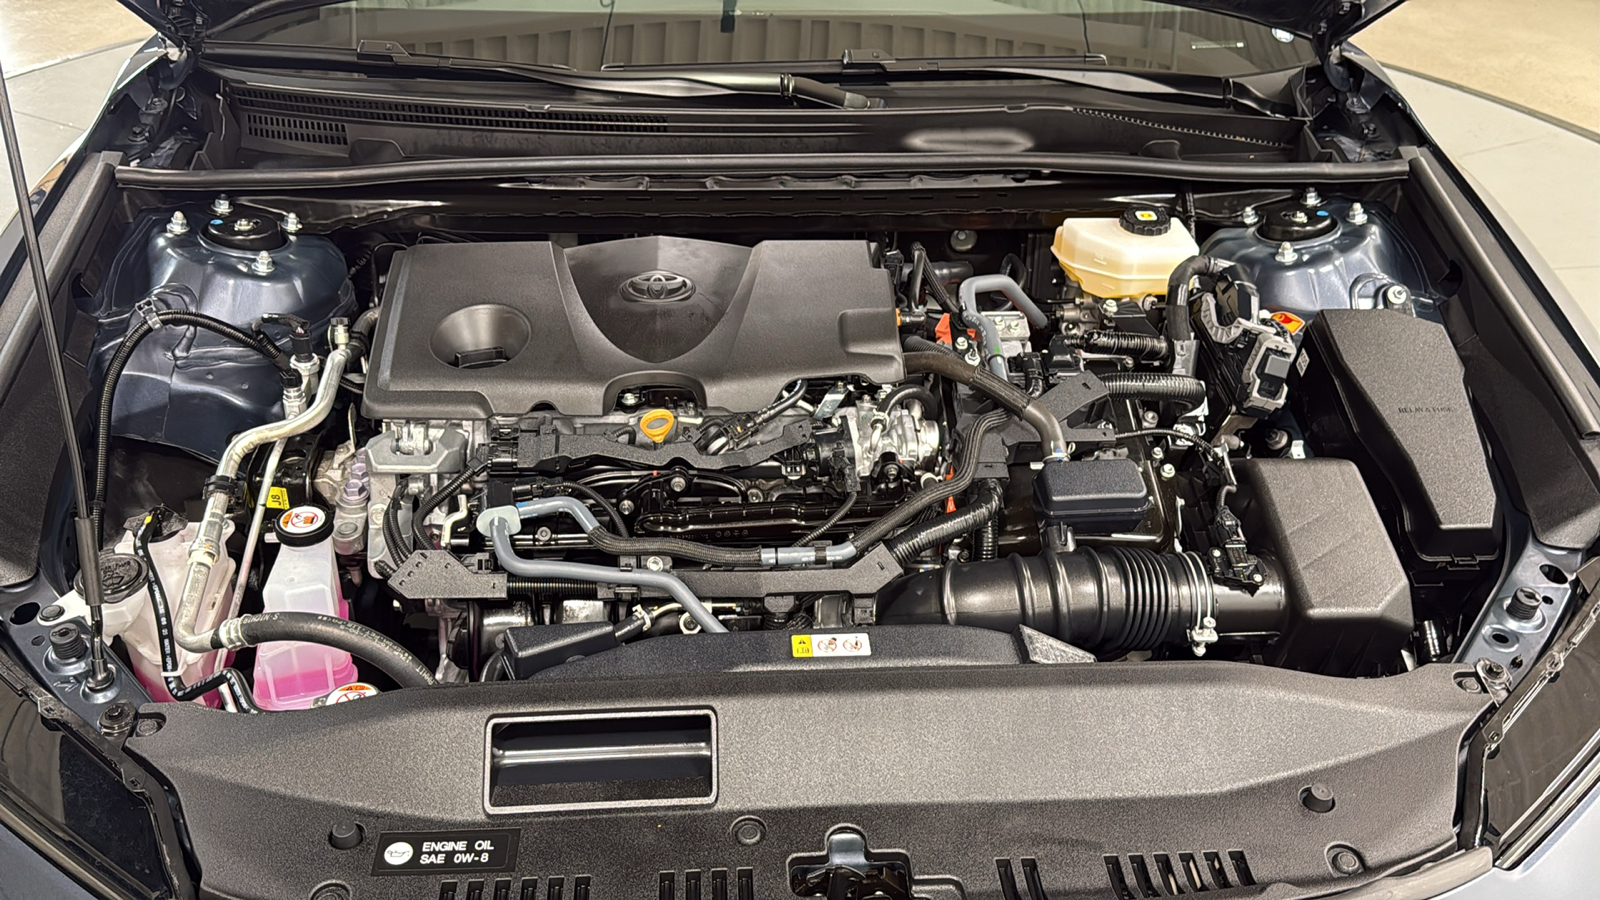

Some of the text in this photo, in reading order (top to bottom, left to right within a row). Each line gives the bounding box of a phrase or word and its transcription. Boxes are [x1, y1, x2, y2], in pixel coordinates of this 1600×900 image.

[271, 494, 281, 506] J8
[423, 840, 494, 852] ENGINE OIL
[419, 852, 489, 864] SAE 0W-8
